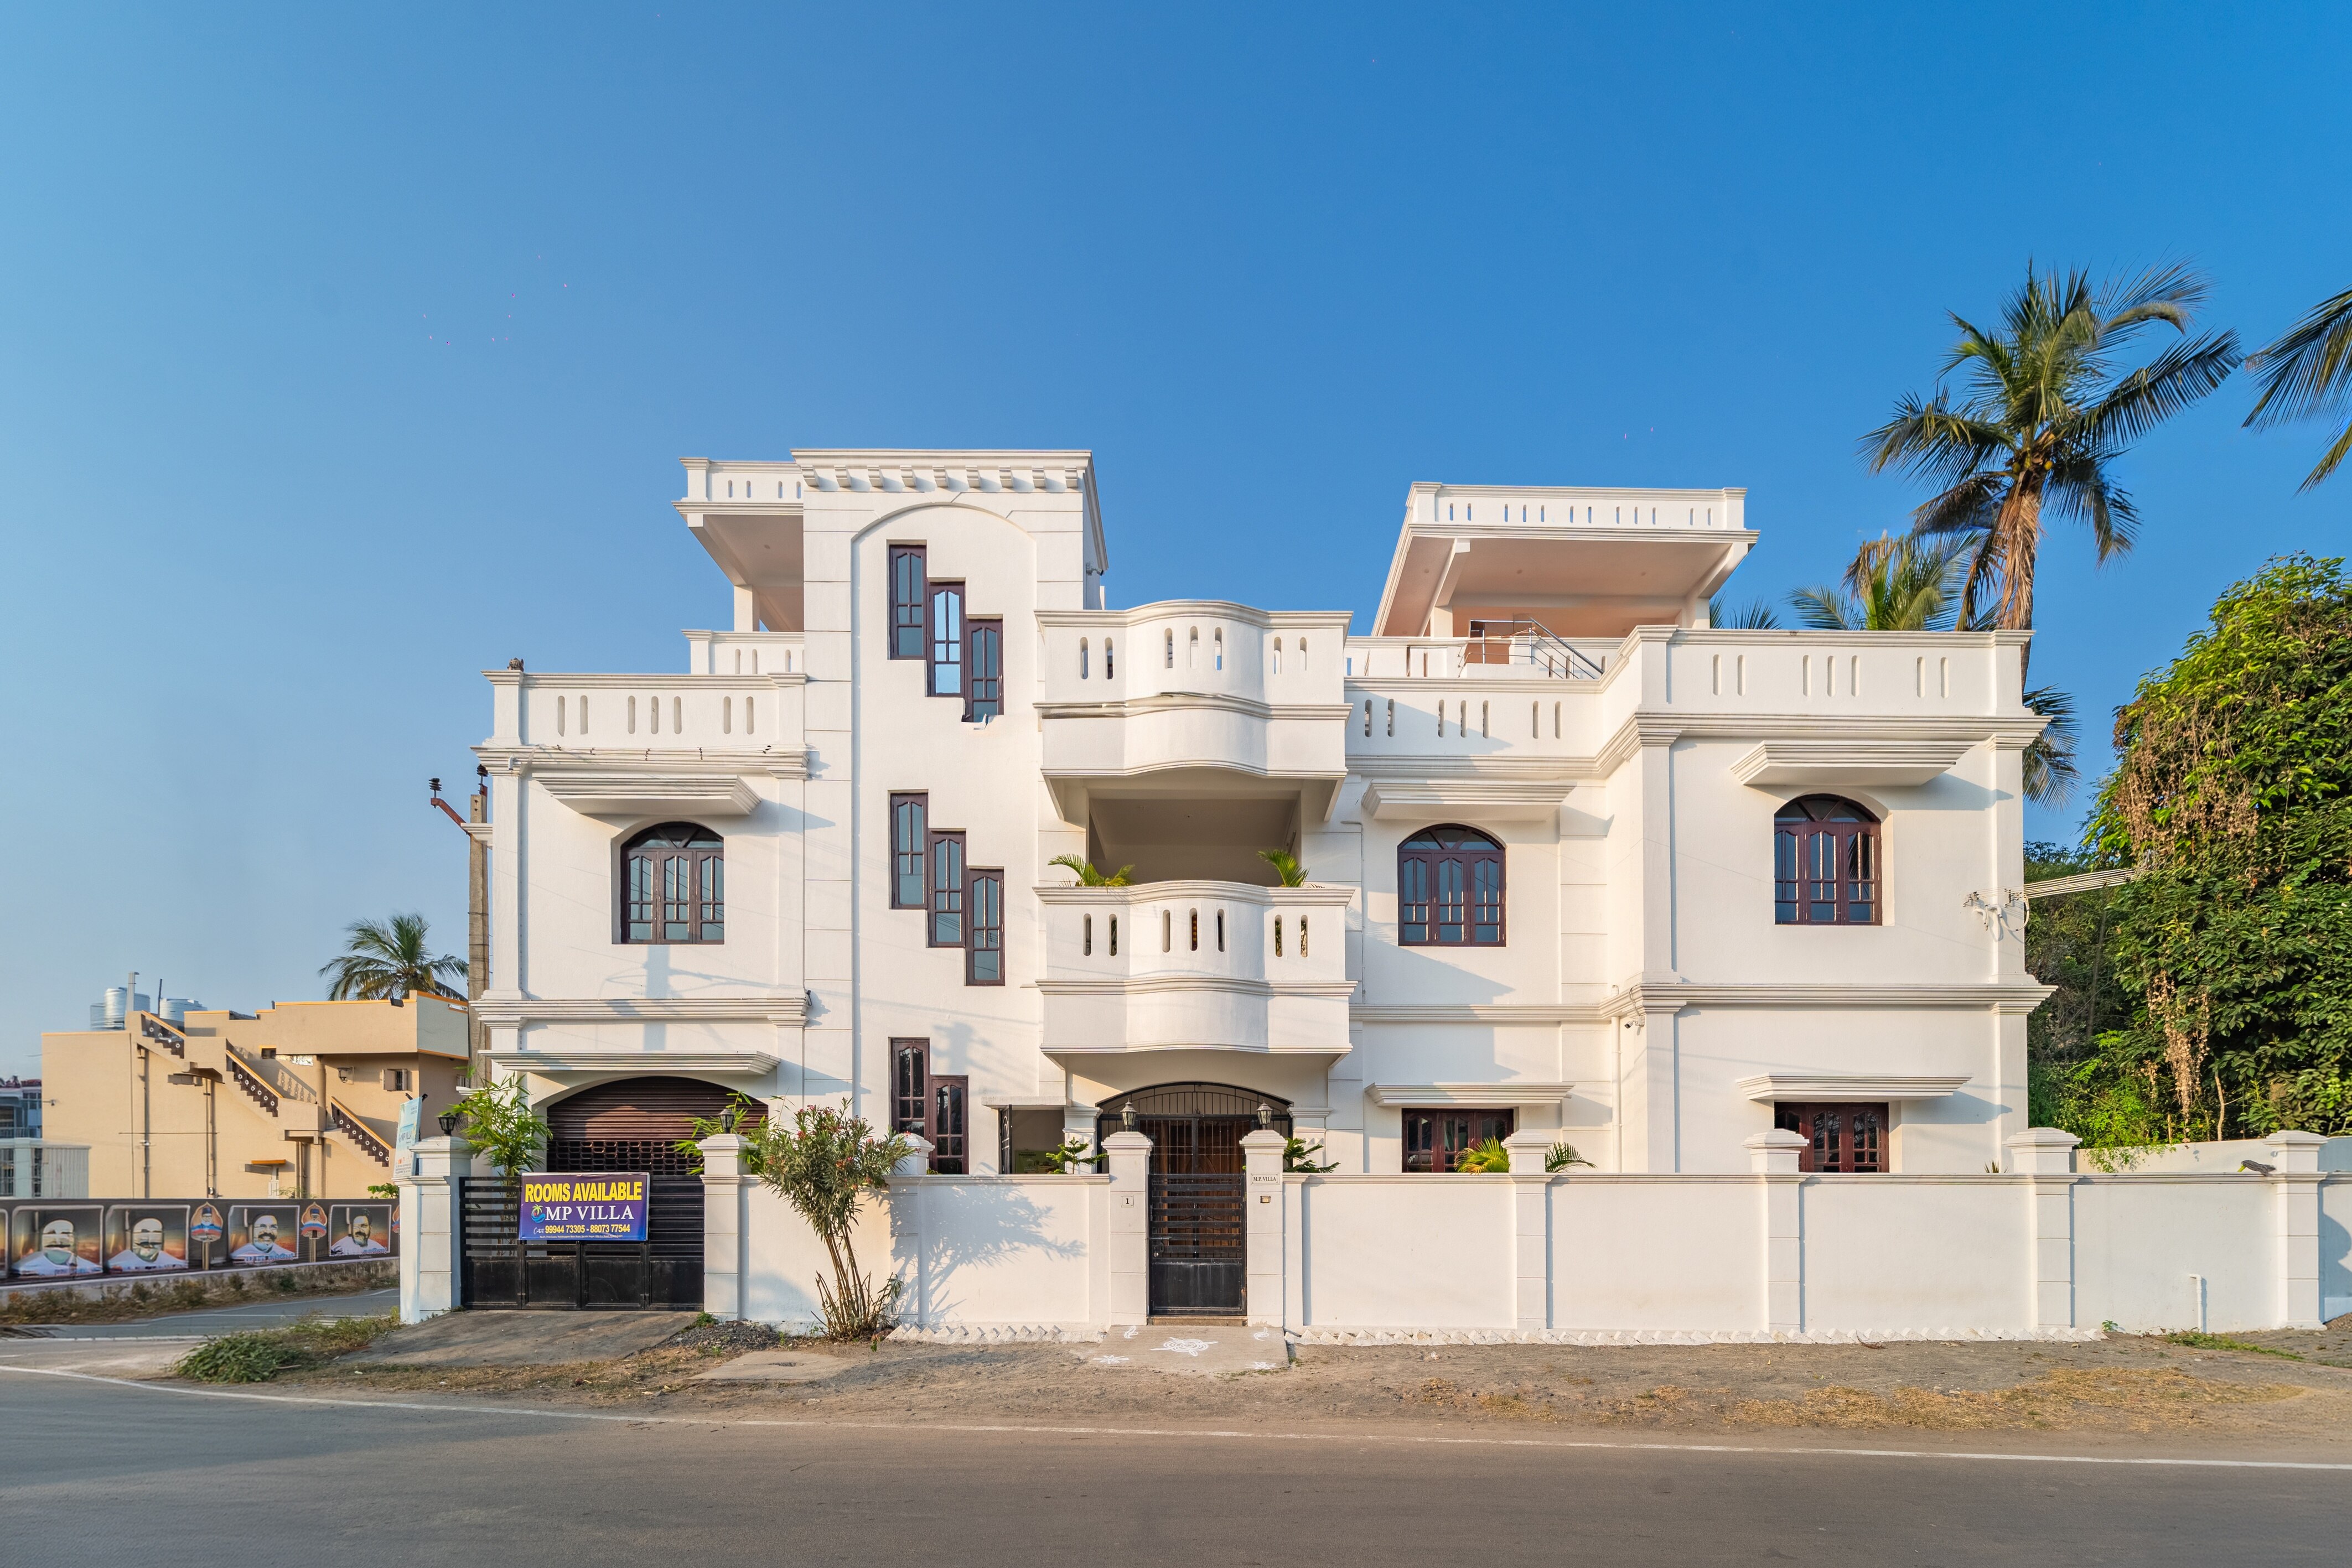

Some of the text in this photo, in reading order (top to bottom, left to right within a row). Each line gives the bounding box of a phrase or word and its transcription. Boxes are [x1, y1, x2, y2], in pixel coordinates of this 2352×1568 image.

[525, 1182, 643, 1202] ROOMS AVAILABLE
[545, 1205, 634, 1221] MP VILLA
[545, 1225, 564, 1234] 99944
[566, 1224, 586, 1233] 73305
[590, 1224, 609, 1233] 88073
[611, 1224, 630, 1233] 77544
